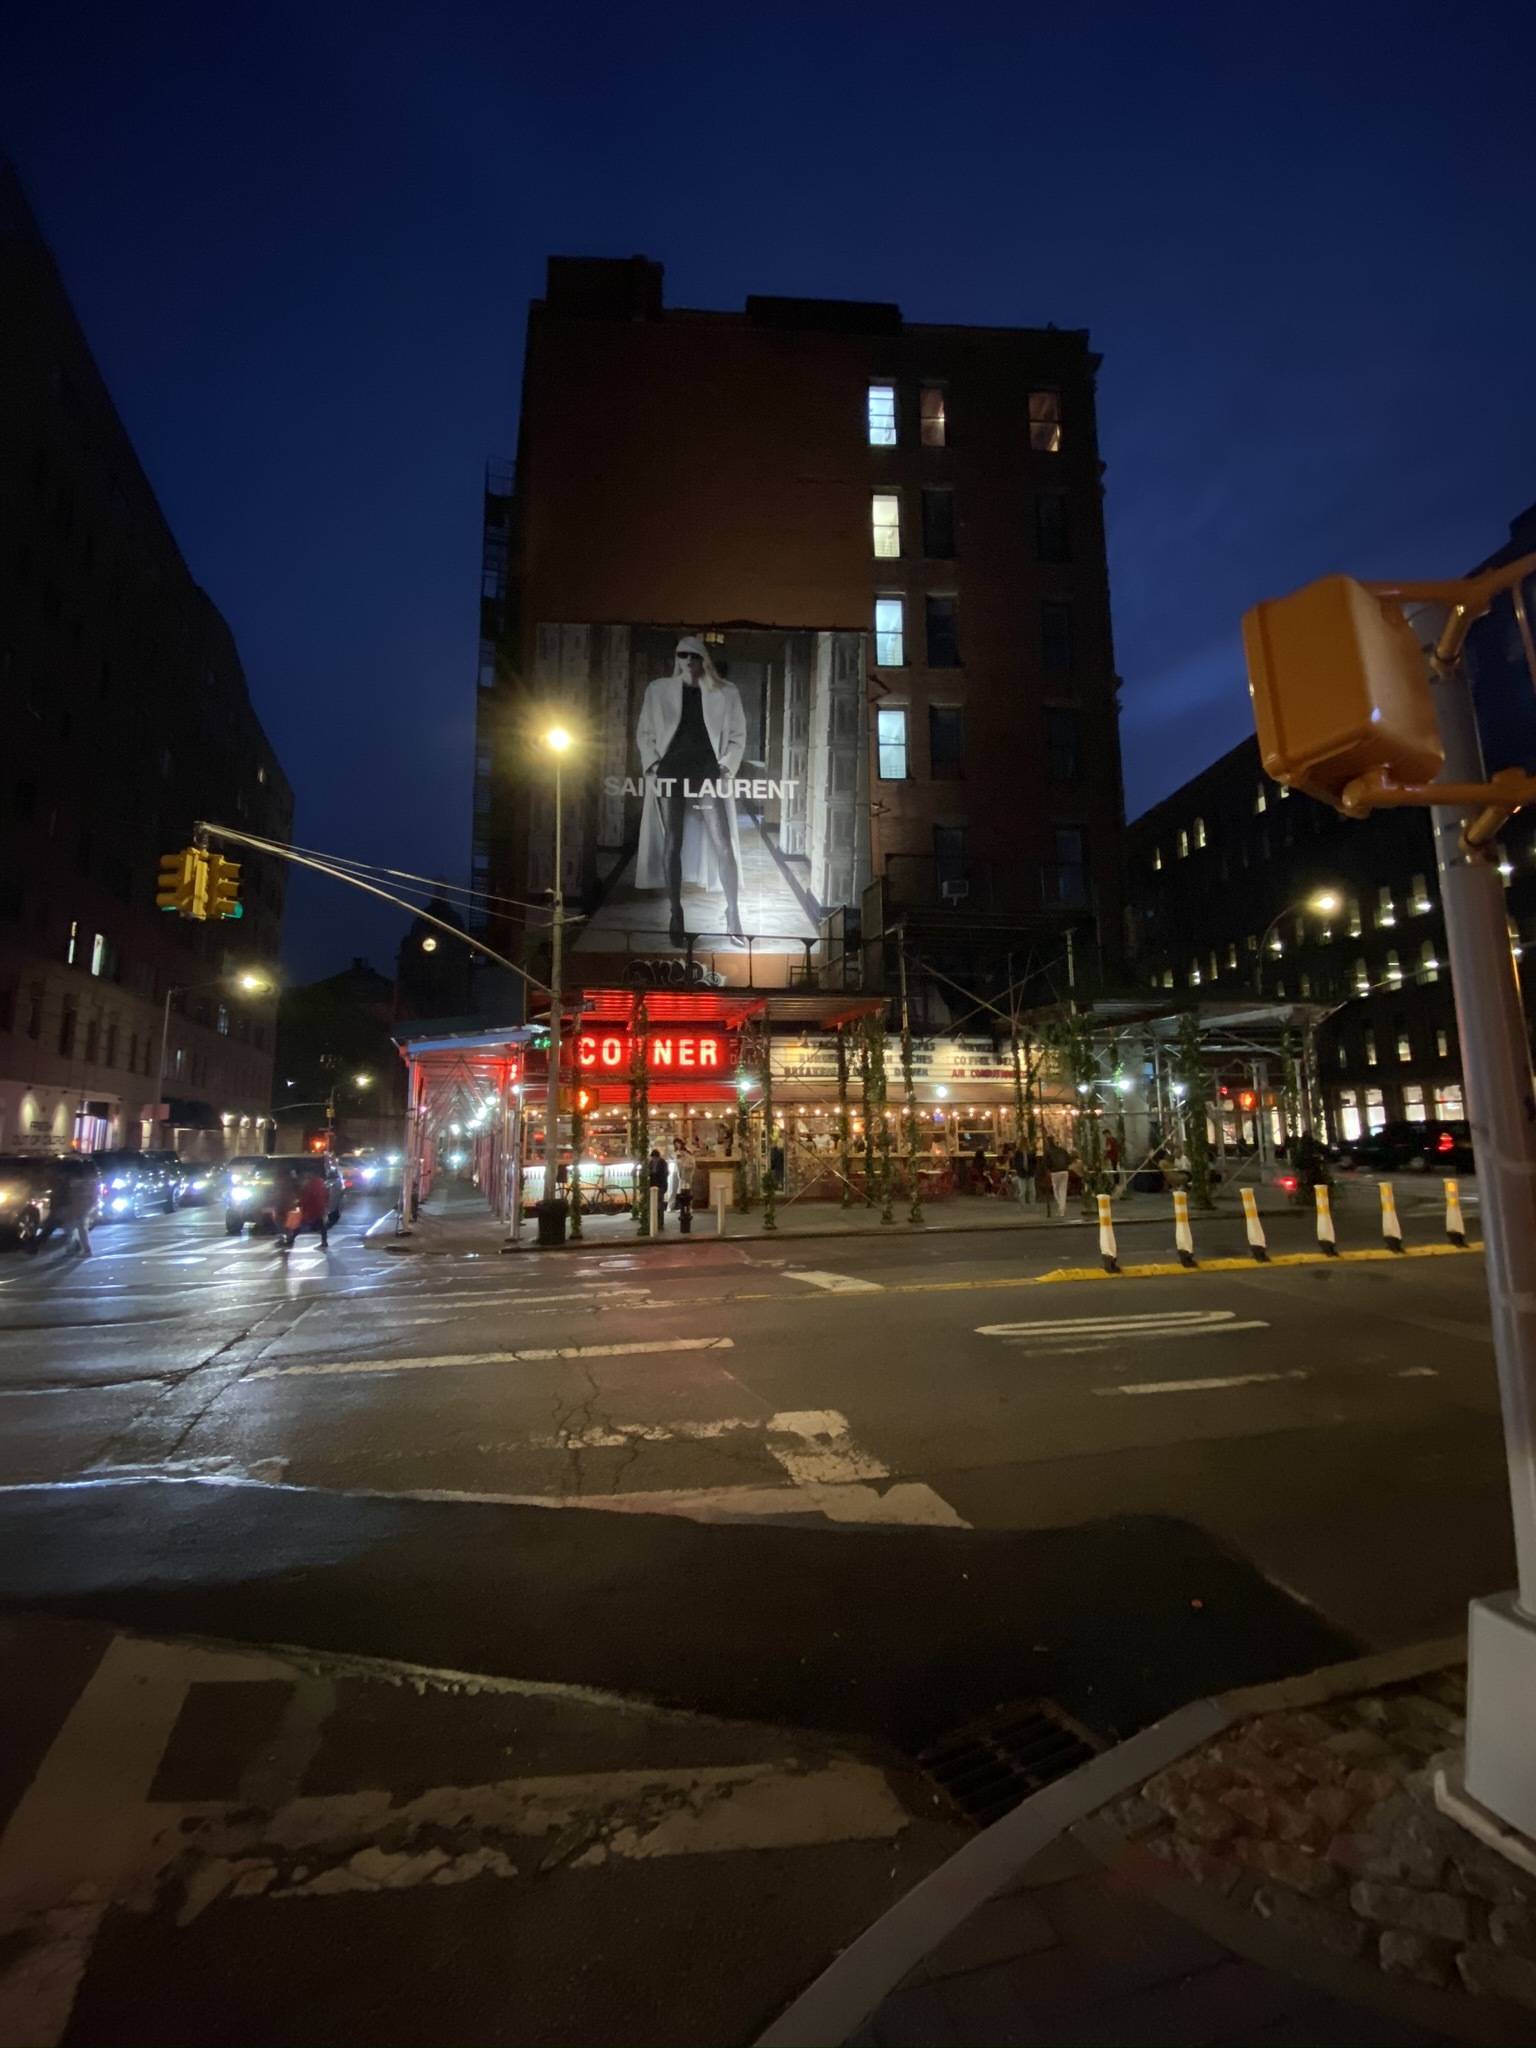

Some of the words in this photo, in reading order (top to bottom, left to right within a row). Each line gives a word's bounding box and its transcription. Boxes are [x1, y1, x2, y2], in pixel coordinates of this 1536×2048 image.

[603, 776, 676, 798] SAINT
[683, 777, 800, 799] LAURENT
[578, 1036, 718, 1066] CONER
